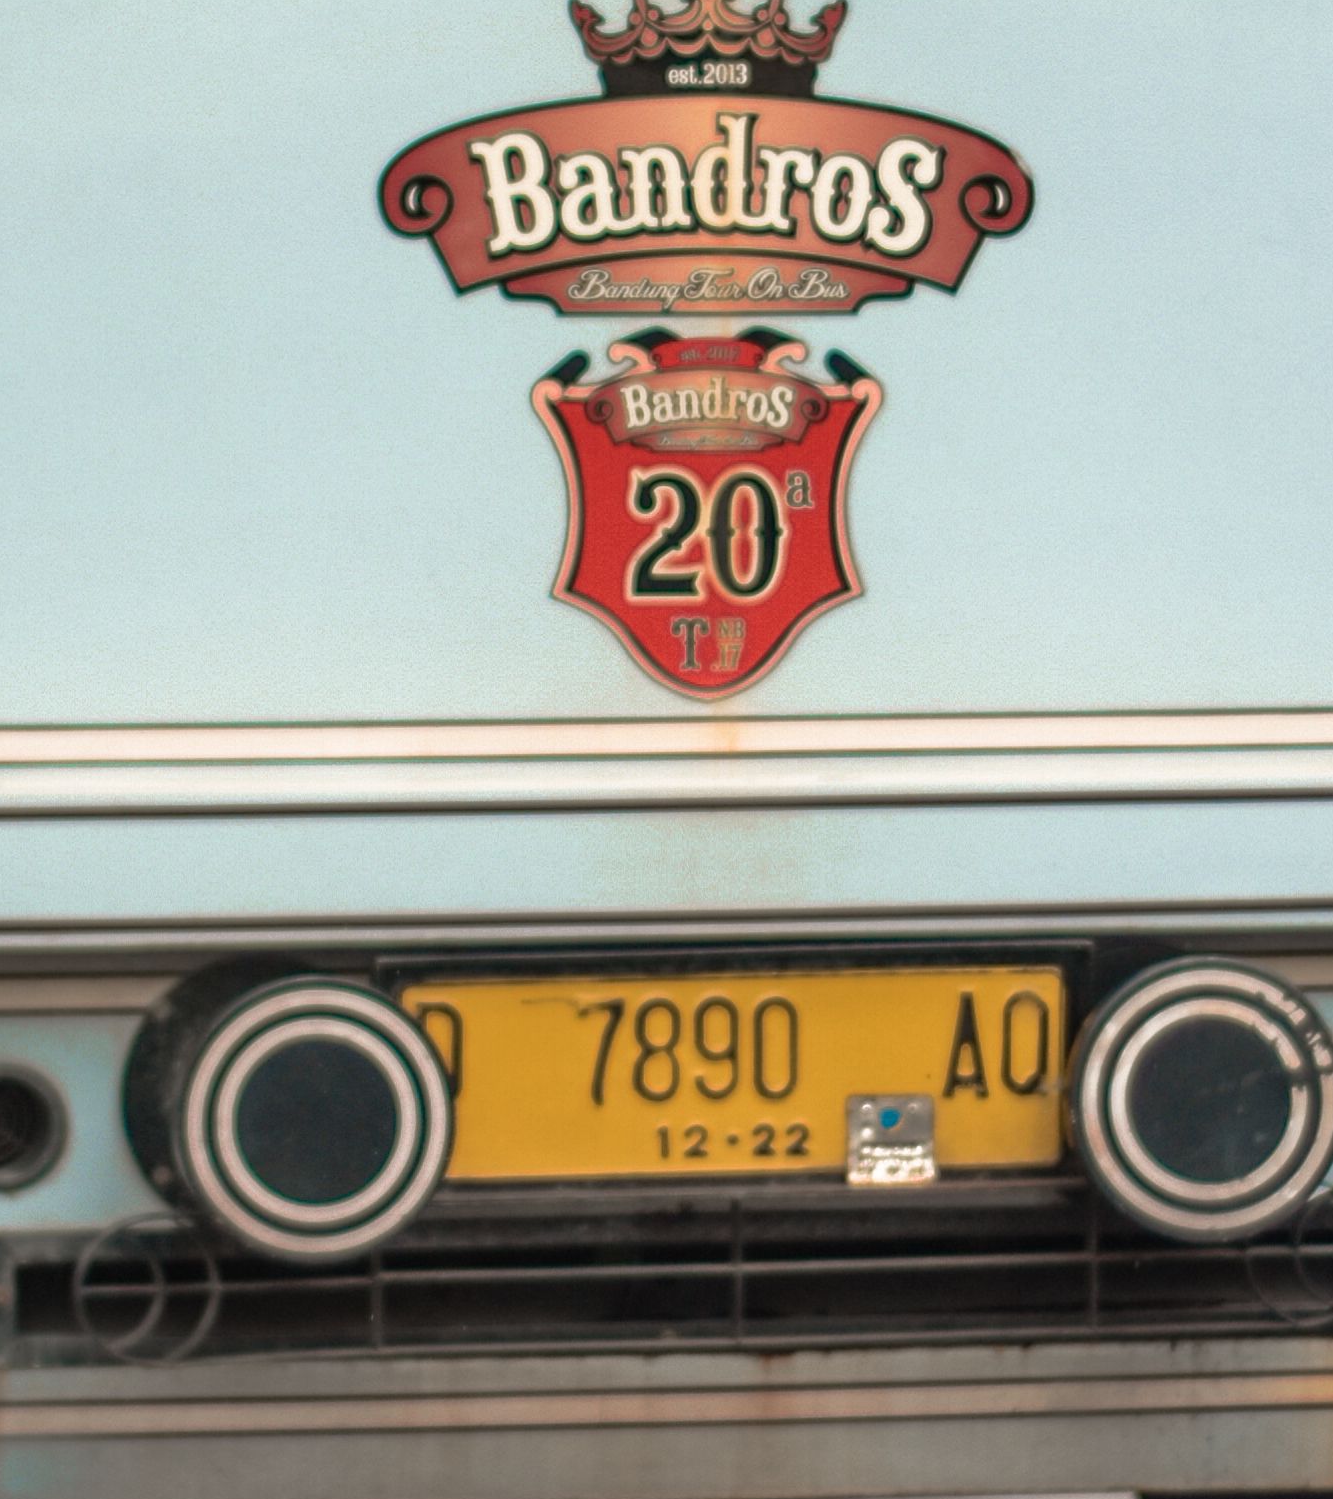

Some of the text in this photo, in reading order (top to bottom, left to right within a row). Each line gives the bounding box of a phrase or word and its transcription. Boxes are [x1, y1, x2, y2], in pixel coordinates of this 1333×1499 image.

[667, 62, 749, 85] est.2013
[469, 112, 945, 258] Bandros
[568, 266, 849, 311] Bandung Tour On Bus
[620, 376, 793, 429] Bandros
[671, 617, 710, 671] T
[576, 993, 800, 1107] 7890
